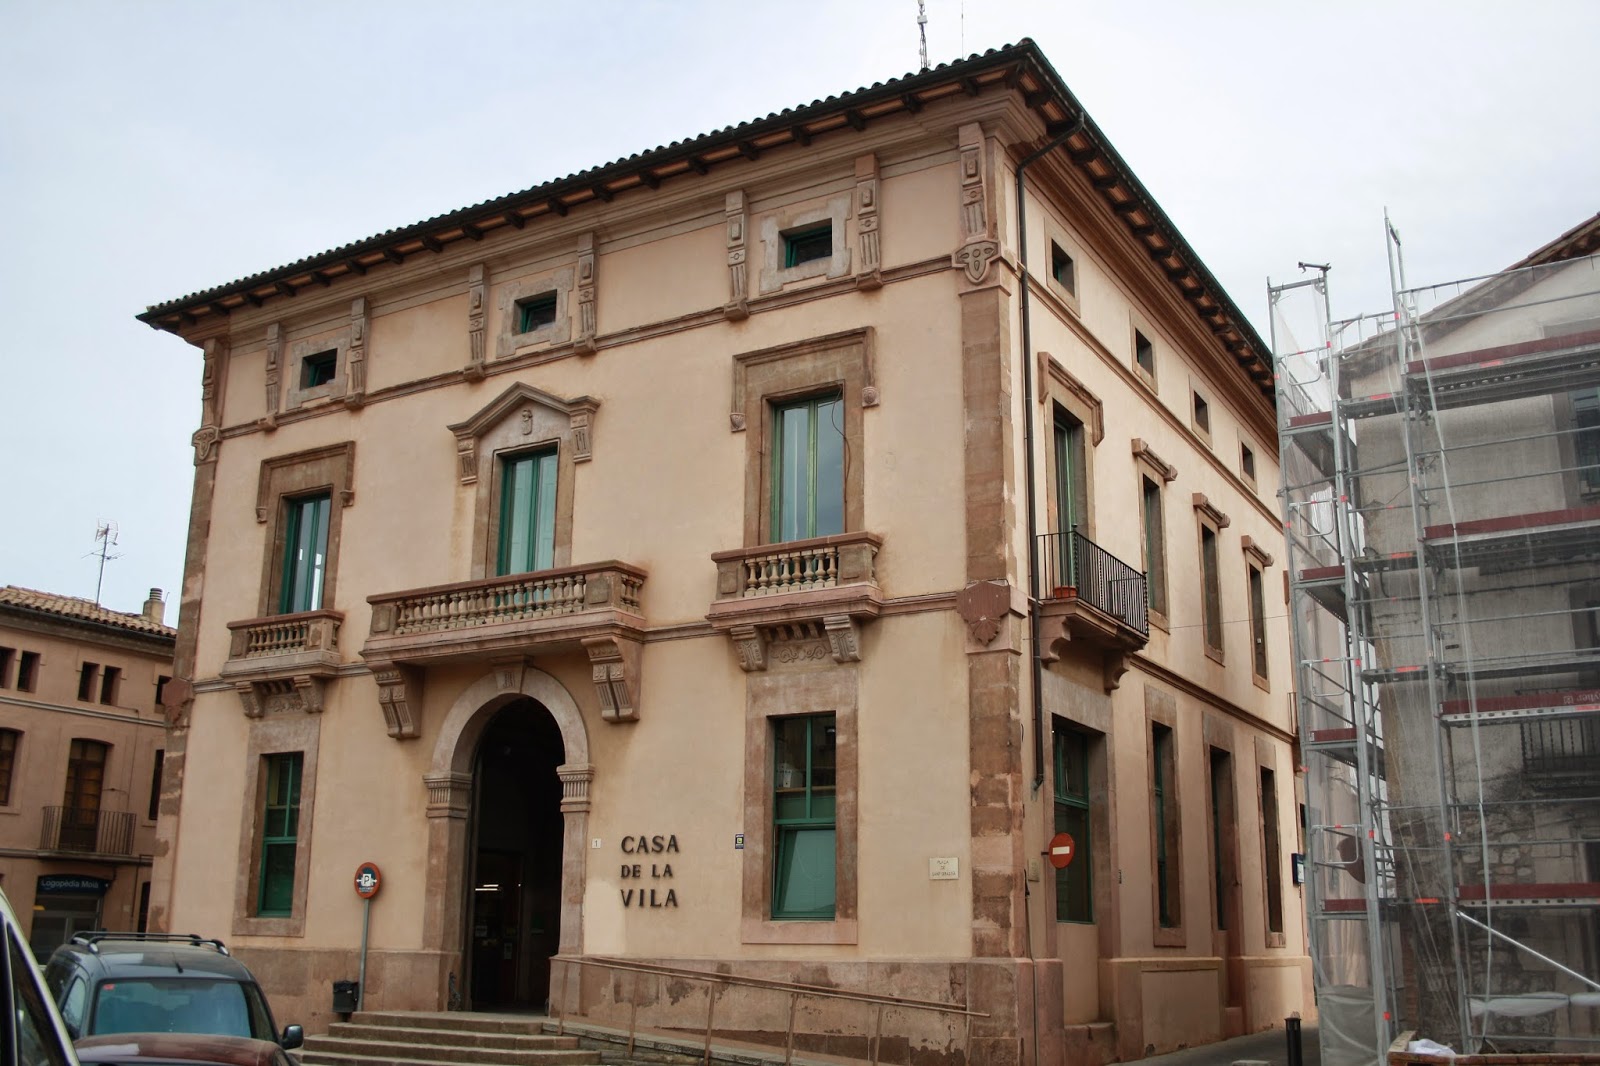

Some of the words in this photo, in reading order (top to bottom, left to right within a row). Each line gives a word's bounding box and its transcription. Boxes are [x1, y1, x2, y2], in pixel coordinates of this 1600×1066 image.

[621, 835, 680, 854] CASA
[620, 864, 641, 878] DE
[651, 864, 673, 878] LA
[41, 879, 80, 889] Logopèdia
[620, 888, 678, 907] VILA
